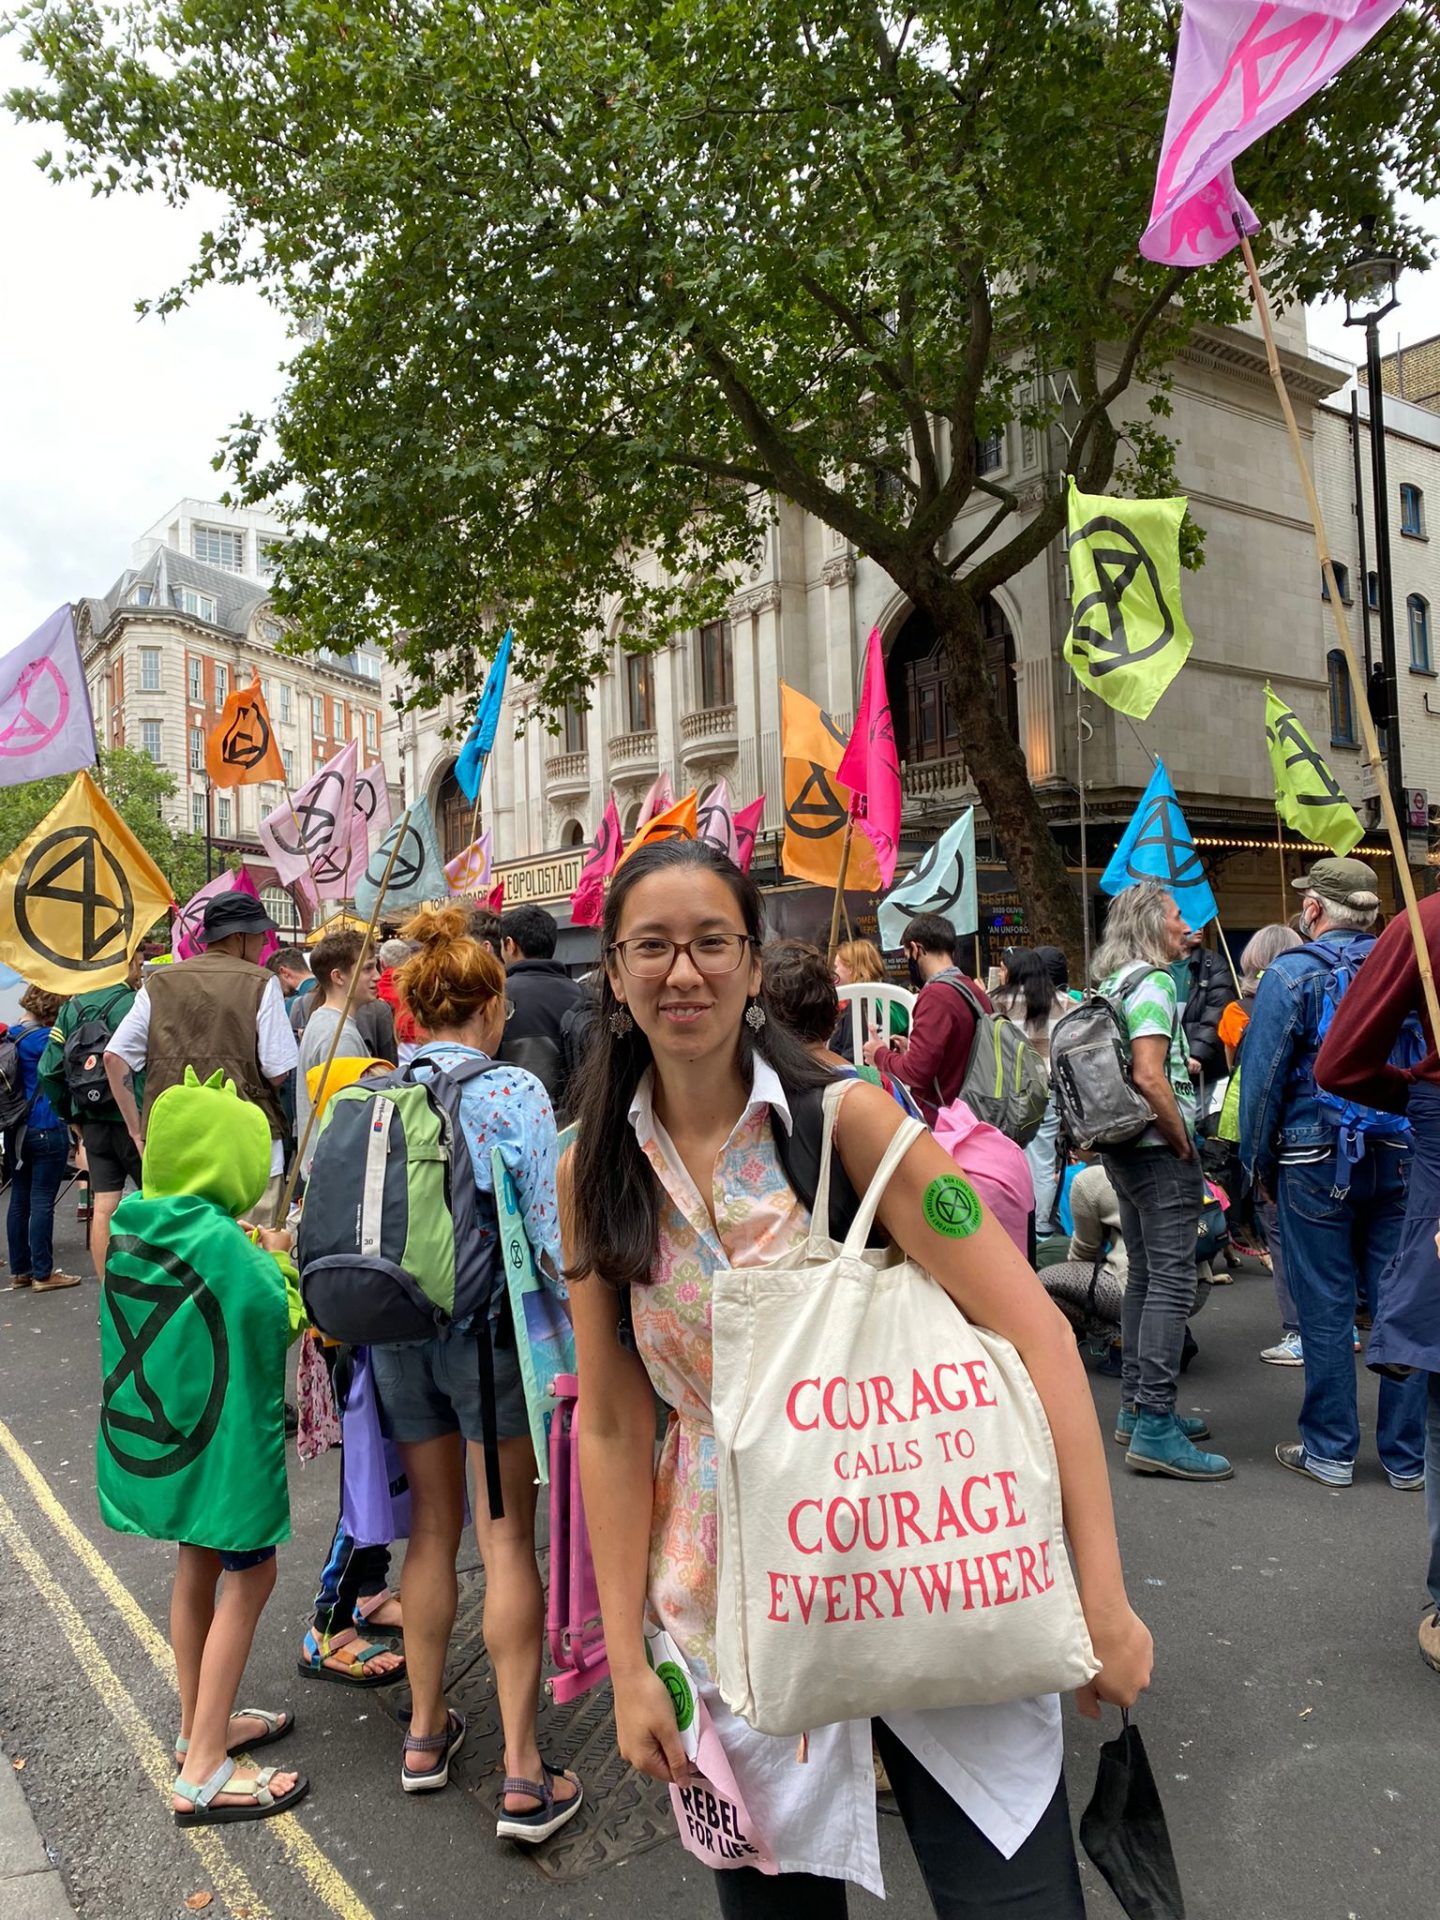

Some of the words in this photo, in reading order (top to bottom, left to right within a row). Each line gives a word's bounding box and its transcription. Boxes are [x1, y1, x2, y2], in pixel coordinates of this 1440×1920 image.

[786, 1360, 998, 1432] COURAGE
[834, 1438, 923, 1481] CALLS
[935, 1428, 976, 1463] TO
[787, 1471, 1028, 1555] COURAGE
[766, 1539, 1056, 1625] EVERYWHERE
[679, 1785, 748, 1842] REBEL
[686, 1814, 716, 1854] FOR
[717, 1834, 760, 1860] LIFE
